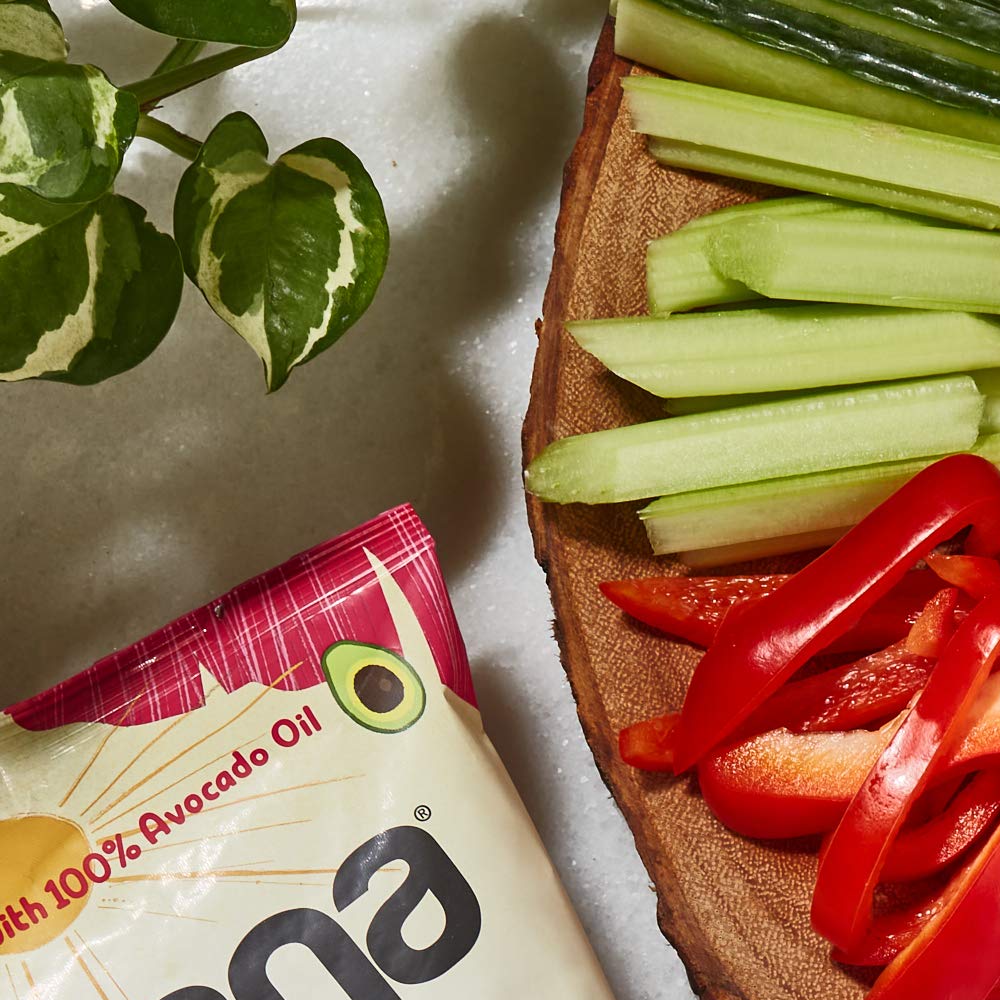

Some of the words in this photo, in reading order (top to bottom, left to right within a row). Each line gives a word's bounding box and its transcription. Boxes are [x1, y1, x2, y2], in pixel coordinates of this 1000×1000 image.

[0, 896, 48, 946] ith
[44, 833, 141, 910] 100%
[138, 748, 269, 844] Avocado
[271, 705, 322, 747] Oil
